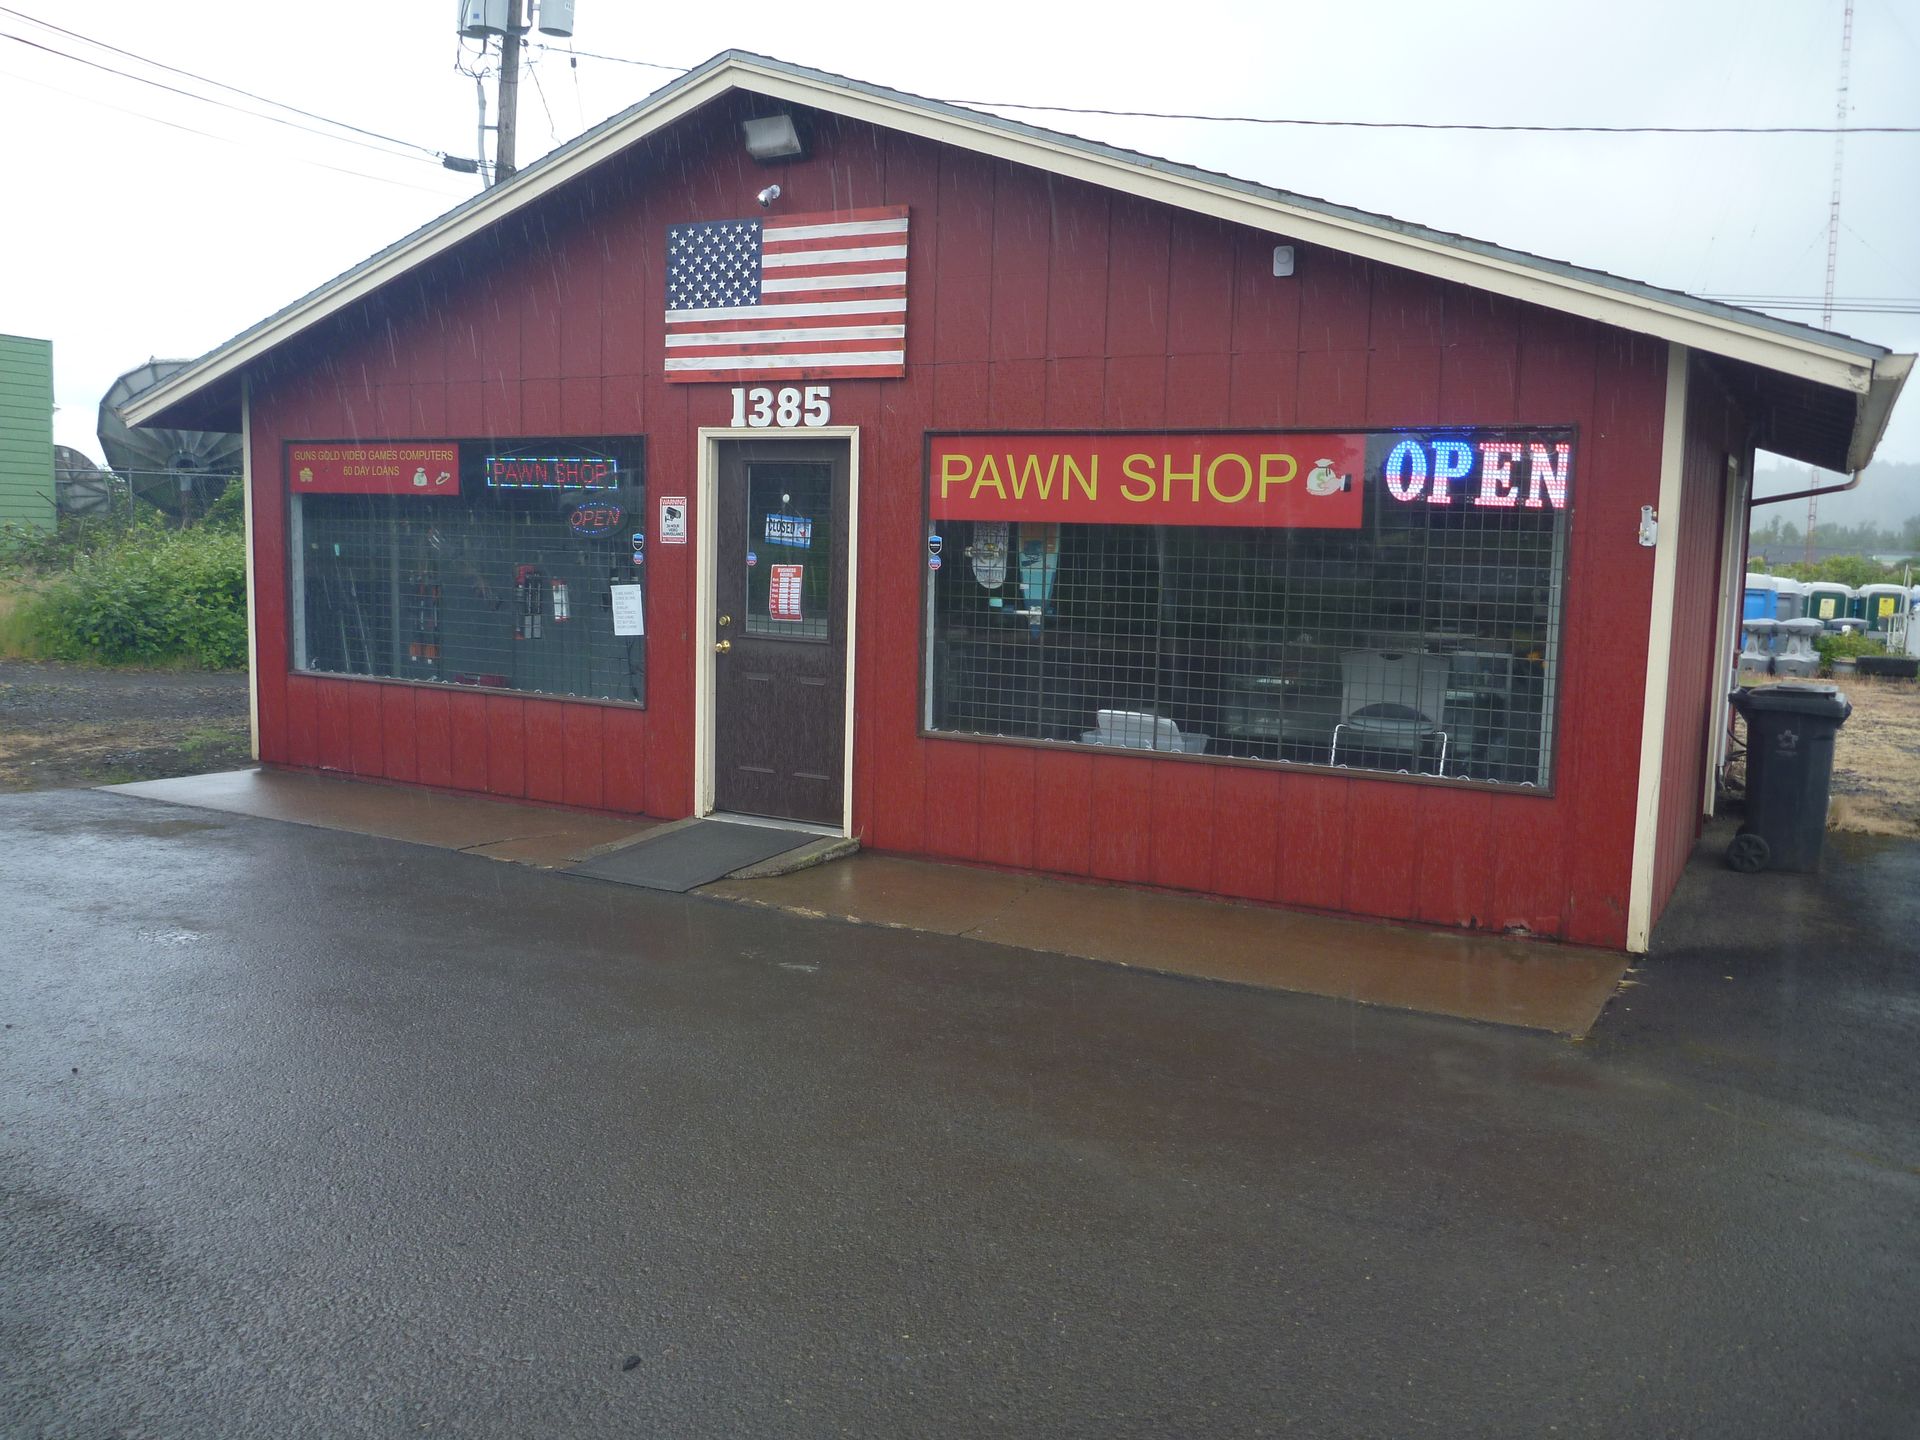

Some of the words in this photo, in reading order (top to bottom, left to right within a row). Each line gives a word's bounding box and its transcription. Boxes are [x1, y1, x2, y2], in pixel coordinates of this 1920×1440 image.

[731, 386, 830, 428] 1385
[295, 451, 317, 461] GUNS
[318, 451, 341, 461] GOLD
[342, 450, 367, 461] VIDEO
[368, 450, 398, 461] GAMES
[399, 450, 454, 461] COMPUTERS
[343, 466, 353, 476] 60
[354, 466, 370, 476] DAY
[372, 466, 400, 476] LOANS
[493, 463, 548, 482] PAWN
[556, 463, 607, 484] SHOP
[941, 453, 1099, 501] PAWN
[1120, 453, 1298, 503] SHOP
[1386, 440, 1570, 508] OPEN
[571, 510, 620, 526] OPEN
[768, 518, 796, 535] CLOSED
